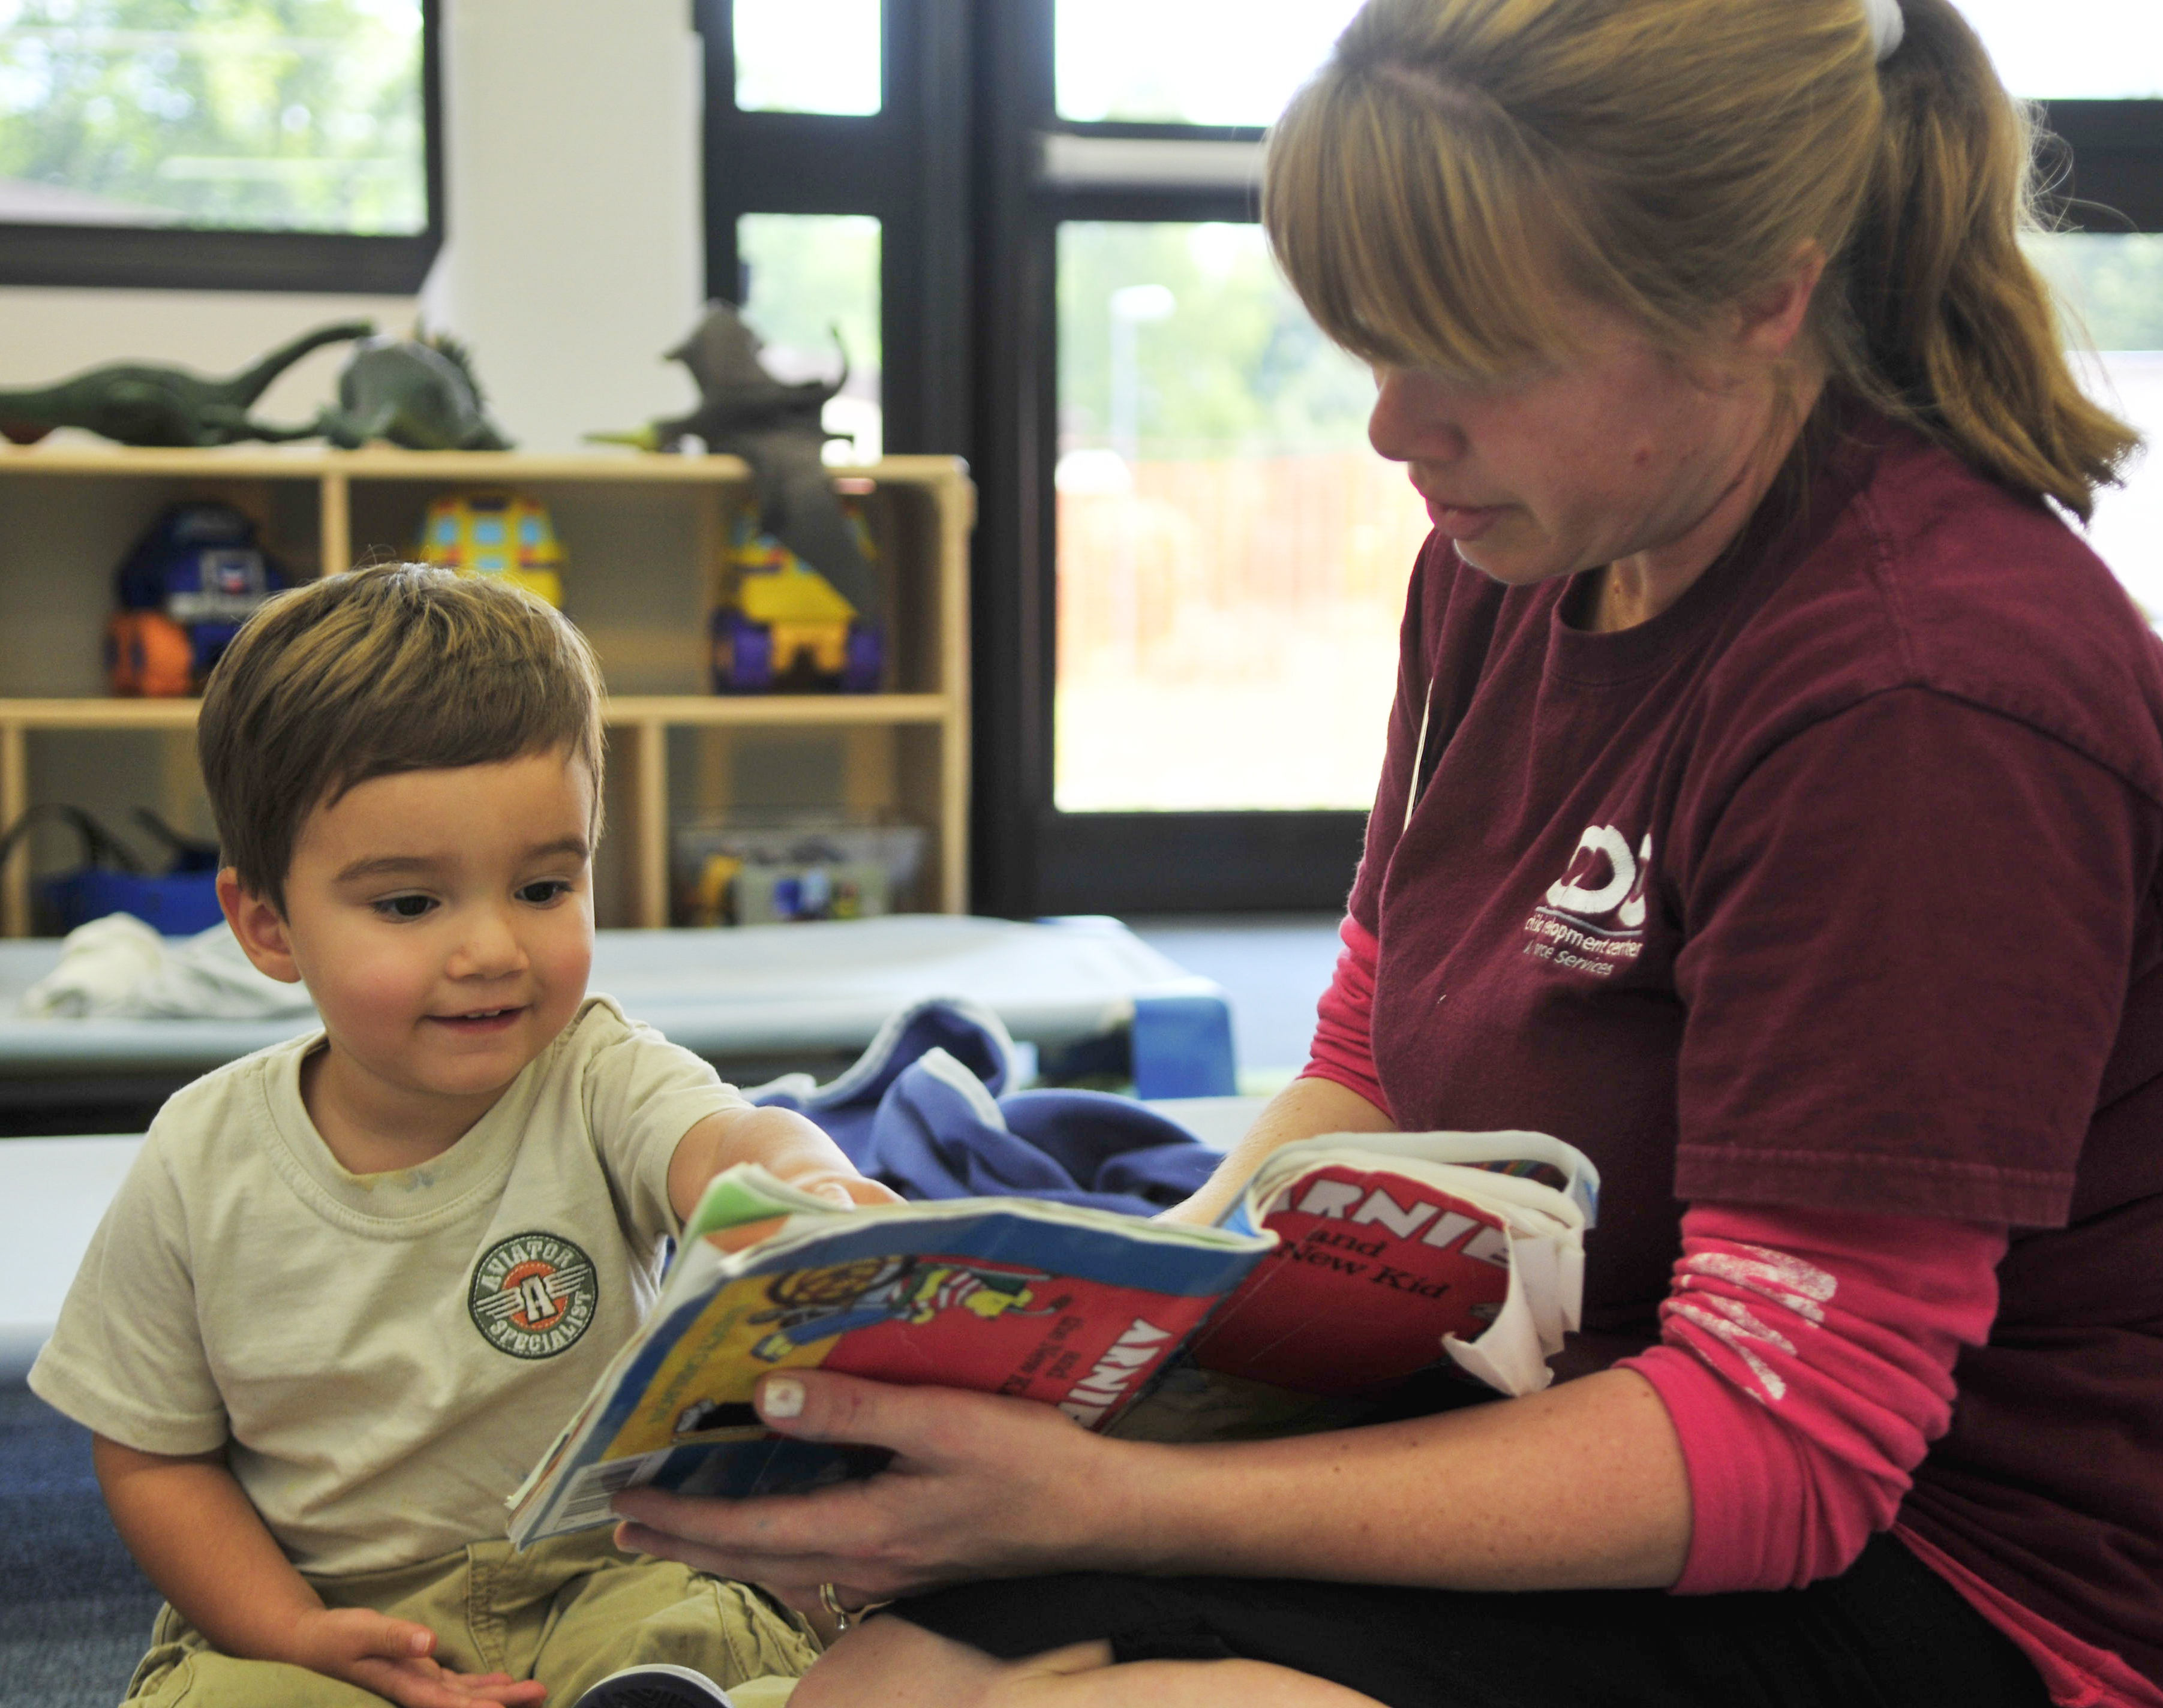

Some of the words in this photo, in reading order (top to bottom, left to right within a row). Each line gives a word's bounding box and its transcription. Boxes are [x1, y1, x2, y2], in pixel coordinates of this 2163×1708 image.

[1554, 950, 1615, 976] Services
[1267, 1178, 1509, 1268] RNIE
[1305, 1229, 1388, 1258] and
[481, 1240, 575, 1292] AVIATOR
[1275, 1239, 1368, 1276] New
[1369, 1265, 1452, 1299] Kid
[489, 1291, 591, 1352] SPECIALIST
[521, 1274, 558, 1325] A
